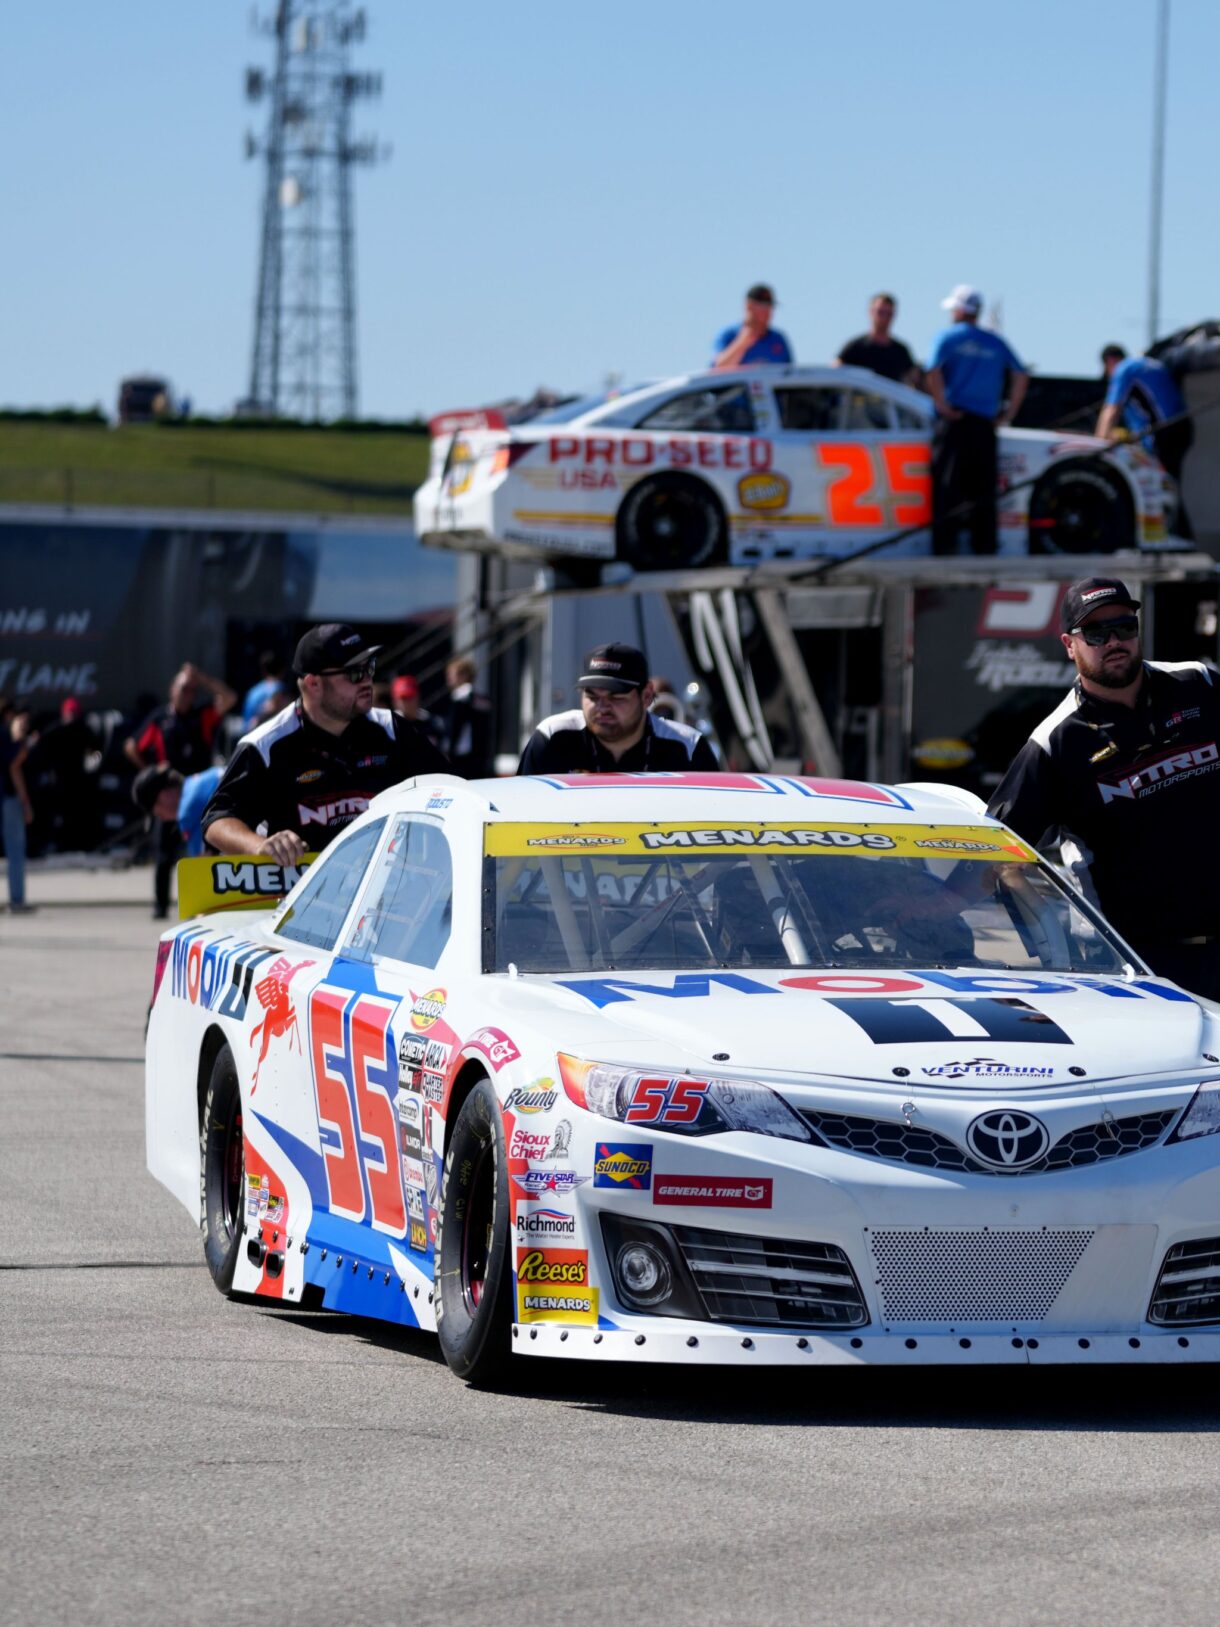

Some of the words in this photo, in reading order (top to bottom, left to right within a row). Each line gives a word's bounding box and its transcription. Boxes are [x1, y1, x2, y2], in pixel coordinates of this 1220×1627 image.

[558, 468, 617, 491] USA
[815, 441, 932, 529] 25
[1096, 743, 1220, 805] NITRO
[297, 797, 370, 826] NITR
[527, 838, 627, 846] MENARDS
[640, 829, 898, 850] MENARDS
[913, 839, 1002, 852] MENARDS
[552, 968, 1199, 1010] Mobil
[920, 1065, 1054, 1075] VENTURINI
[502, 1087, 559, 1112] Bounty
[624, 1078, 711, 1124] 55
[309, 984, 407, 1239] 55
[513, 1129, 551, 1146] Sioux
[511, 1144, 546, 1160] Chief
[595, 1159, 650, 1175] SUNOCO
[525, 1172, 552, 1182] FIVE
[554, 1172, 574, 1184] STAR
[658, 1186, 714, 1197] GENERAL
[715, 1187, 743, 1198] TIRE
[517, 1215, 575, 1232] Richmond
[517, 1250, 586, 1283] Reese's
[524, 1295, 592, 1312] MENARDS
